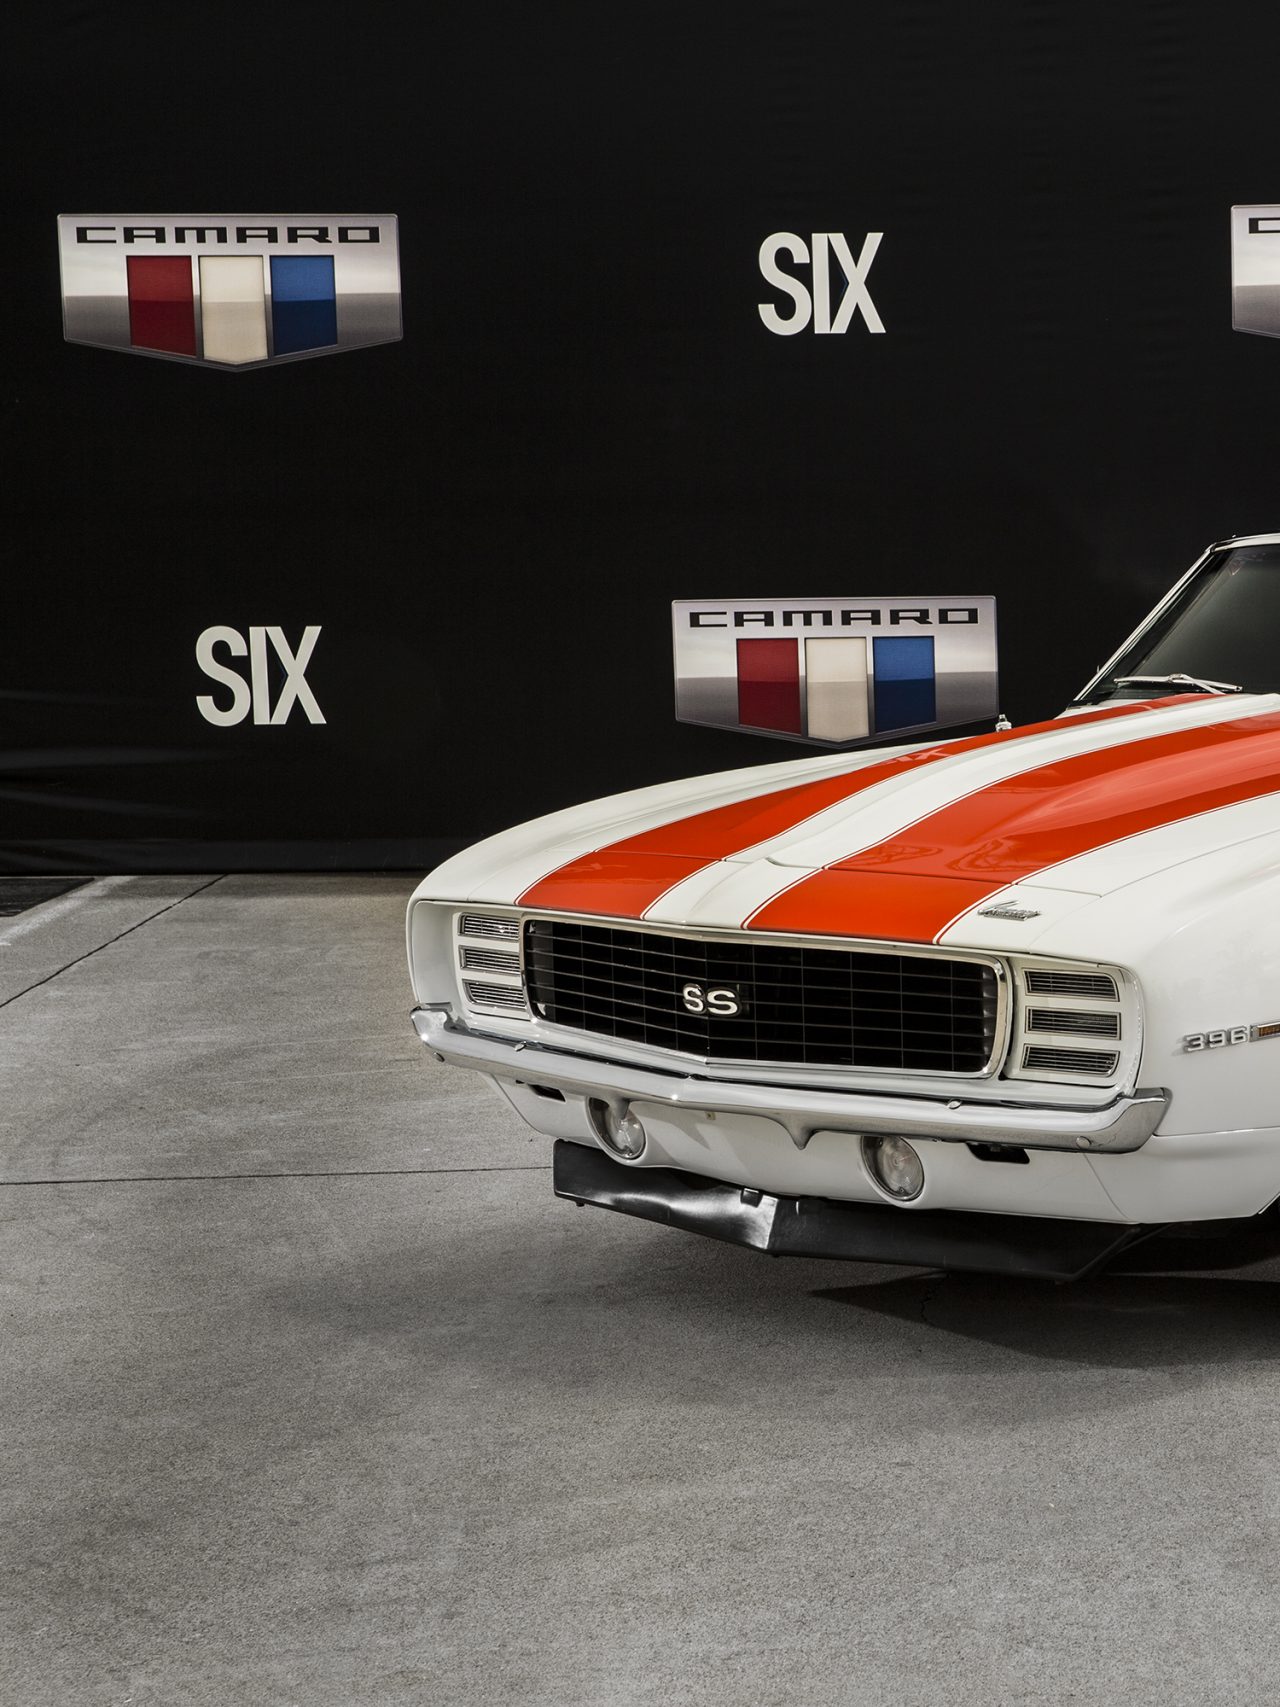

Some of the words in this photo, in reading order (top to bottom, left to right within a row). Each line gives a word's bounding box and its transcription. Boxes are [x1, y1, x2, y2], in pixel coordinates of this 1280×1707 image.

[75, 226, 380, 244] CAMARO
[757, 231, 887, 336] SIX
[689, 607, 979, 628] CAMARO
[195, 625, 327, 727] SIX
[682, 982, 742, 1017] SS
[1183, 1025, 1248, 1053] 396
